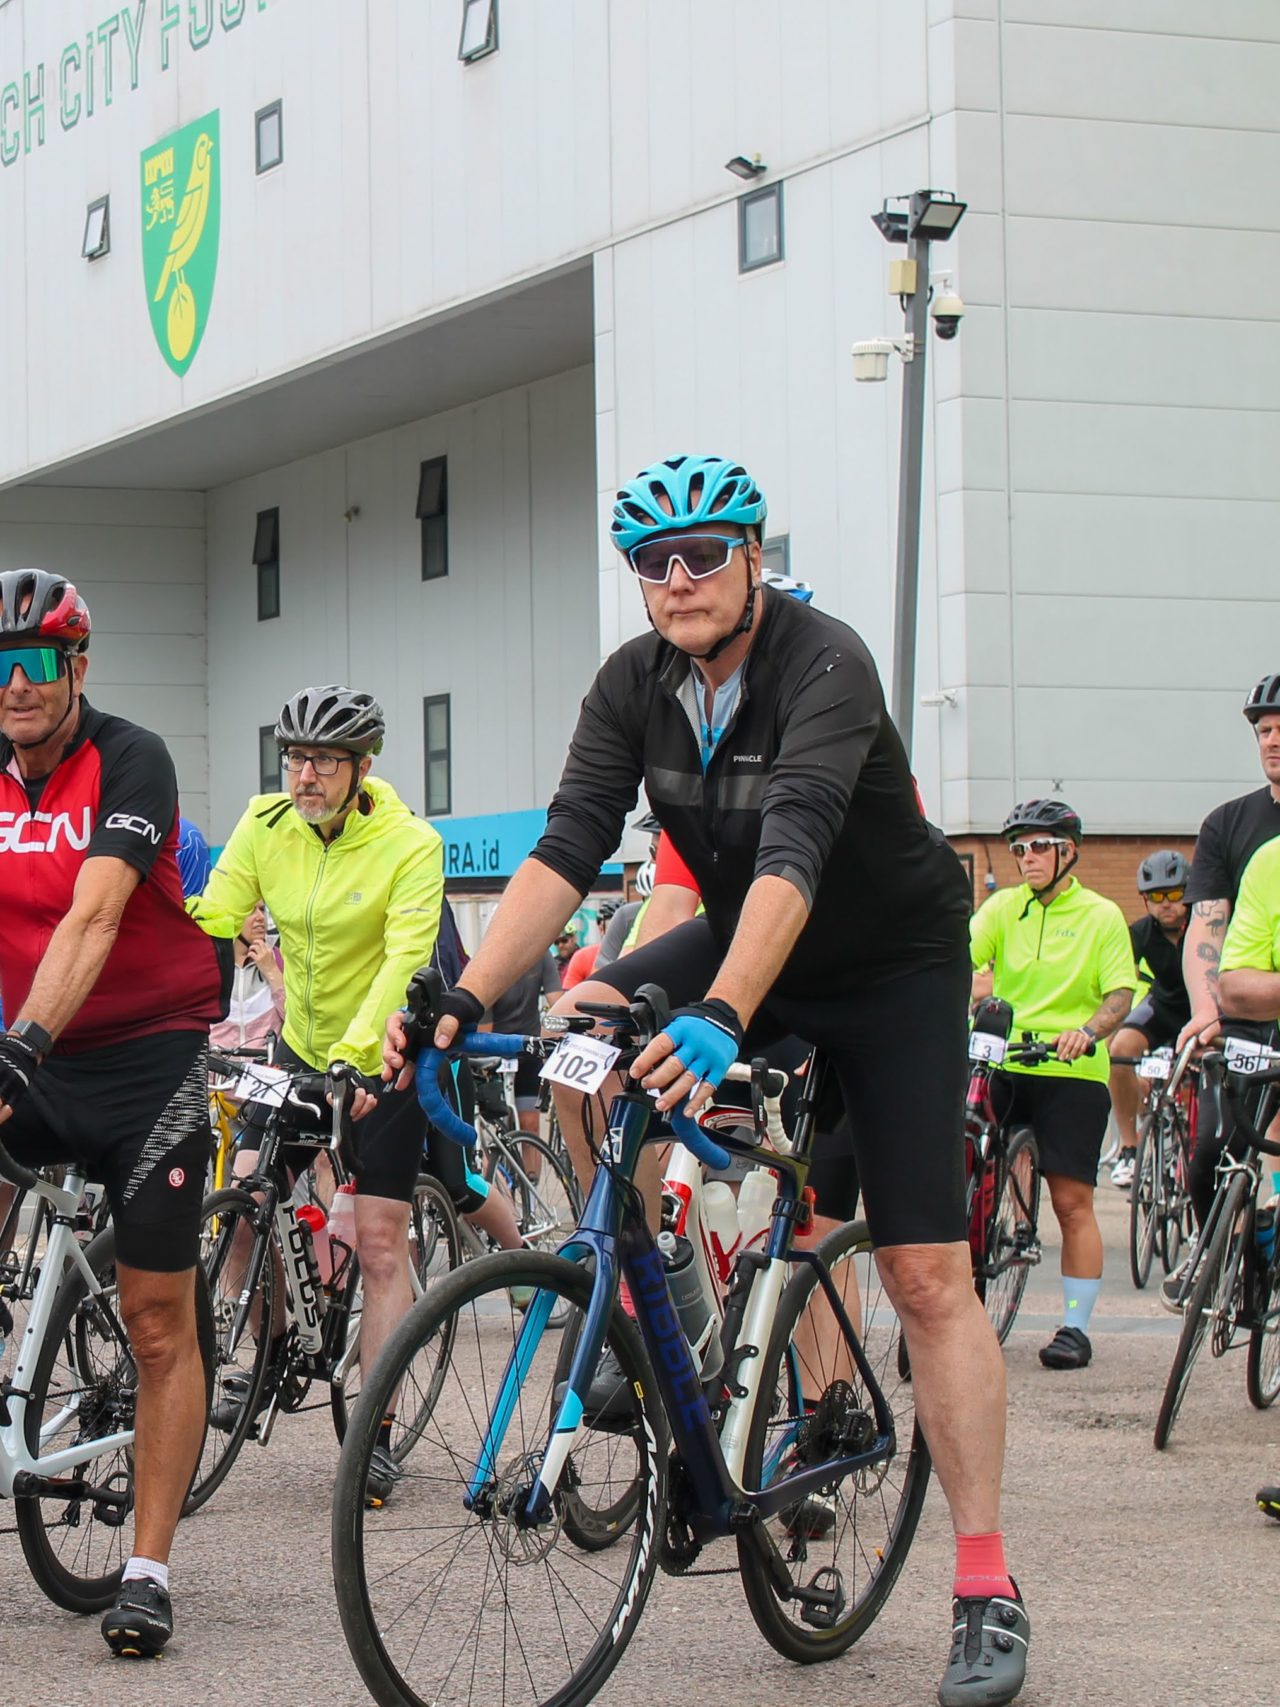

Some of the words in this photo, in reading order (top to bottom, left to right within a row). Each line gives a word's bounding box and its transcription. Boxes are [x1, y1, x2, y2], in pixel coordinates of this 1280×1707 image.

[59, 0, 146, 132] CITY
[105, 812, 162, 845] GCN
[553, 1051, 599, 1086] 102
[982, 1045, 992, 1060] 3
[1233, 1053, 1255, 1072] 56
[282, 1204, 319, 1329] FOCUS
[631, 1250, 707, 1433] RIBBLE
